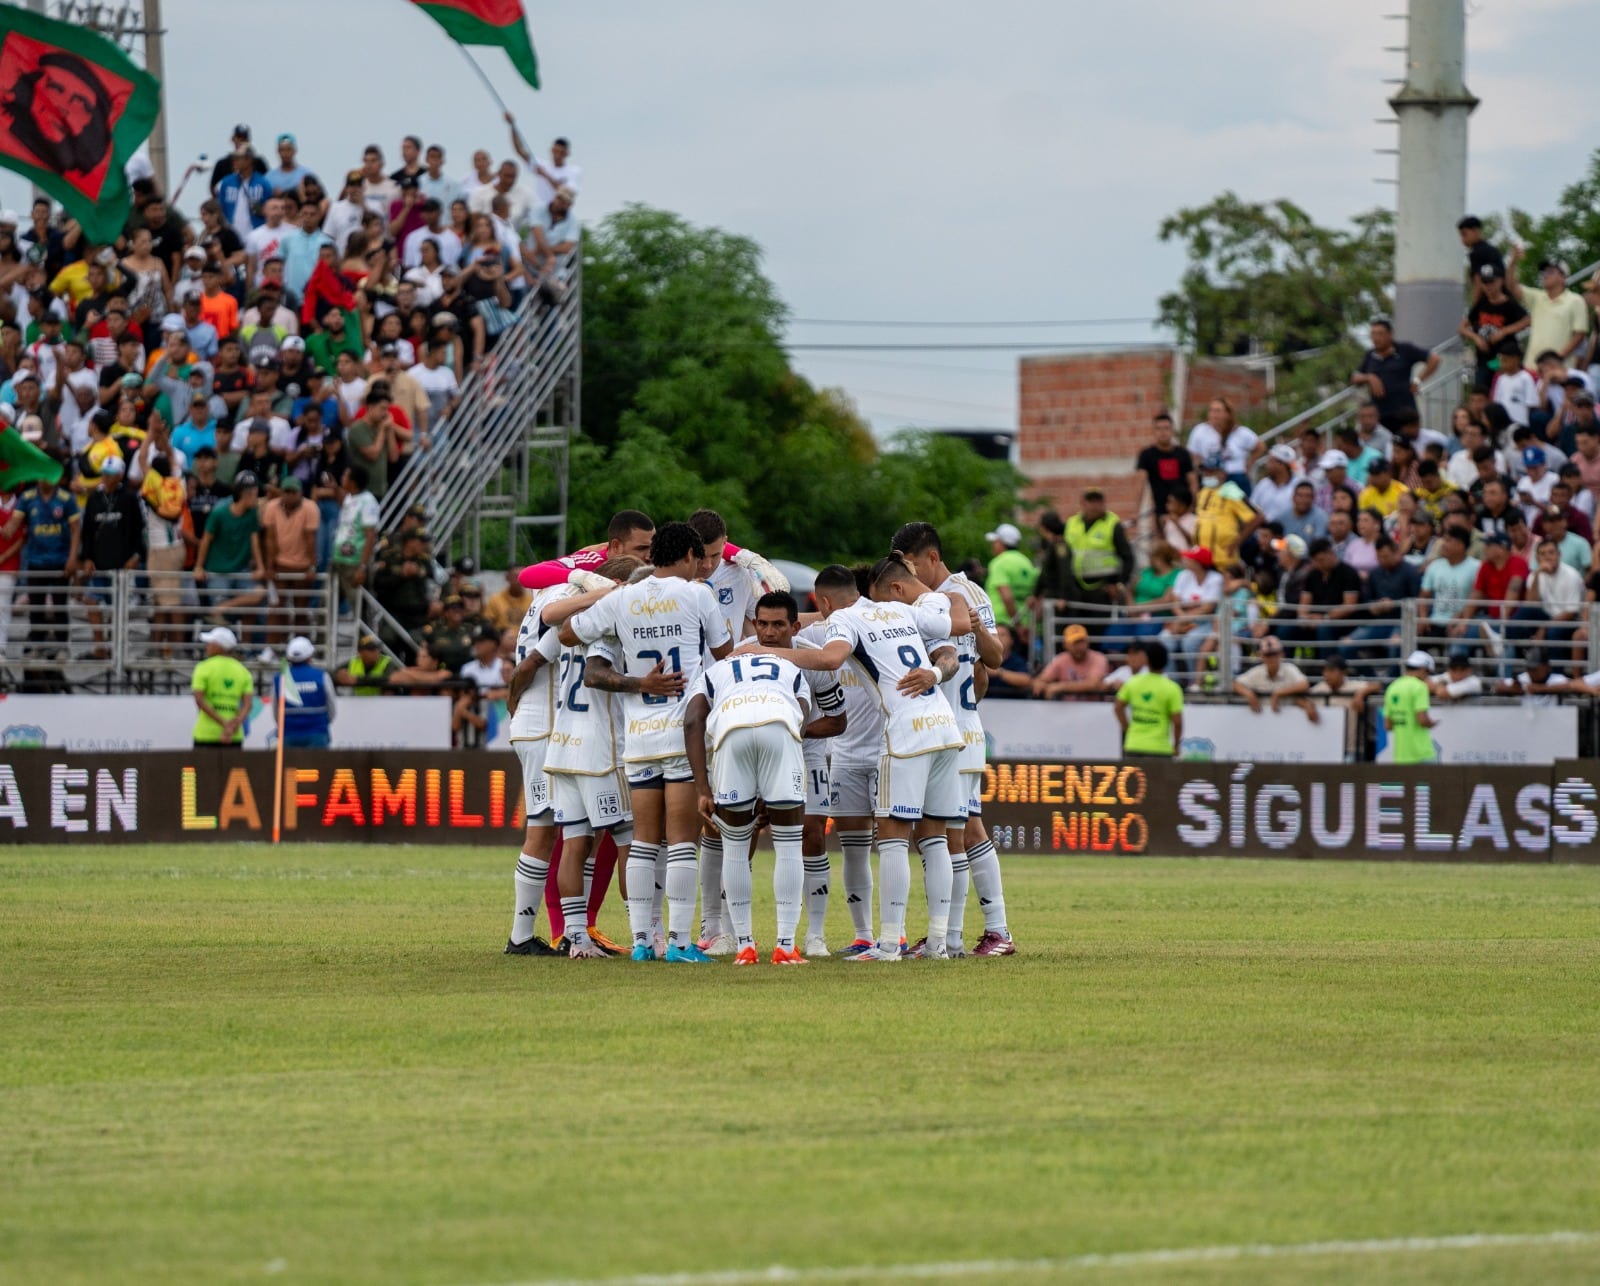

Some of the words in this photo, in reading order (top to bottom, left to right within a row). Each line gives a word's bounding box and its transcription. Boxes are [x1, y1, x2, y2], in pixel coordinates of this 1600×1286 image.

[633, 623, 682, 639] PEREIRA
[867, 632, 882, 643] D.
[728, 656, 780, 684] 15
[51, 763, 138, 832] EN
[181, 765, 262, 831] LA
[892, 804, 921, 815] Allianz
[1052, 811, 1148, 853] NIDO
